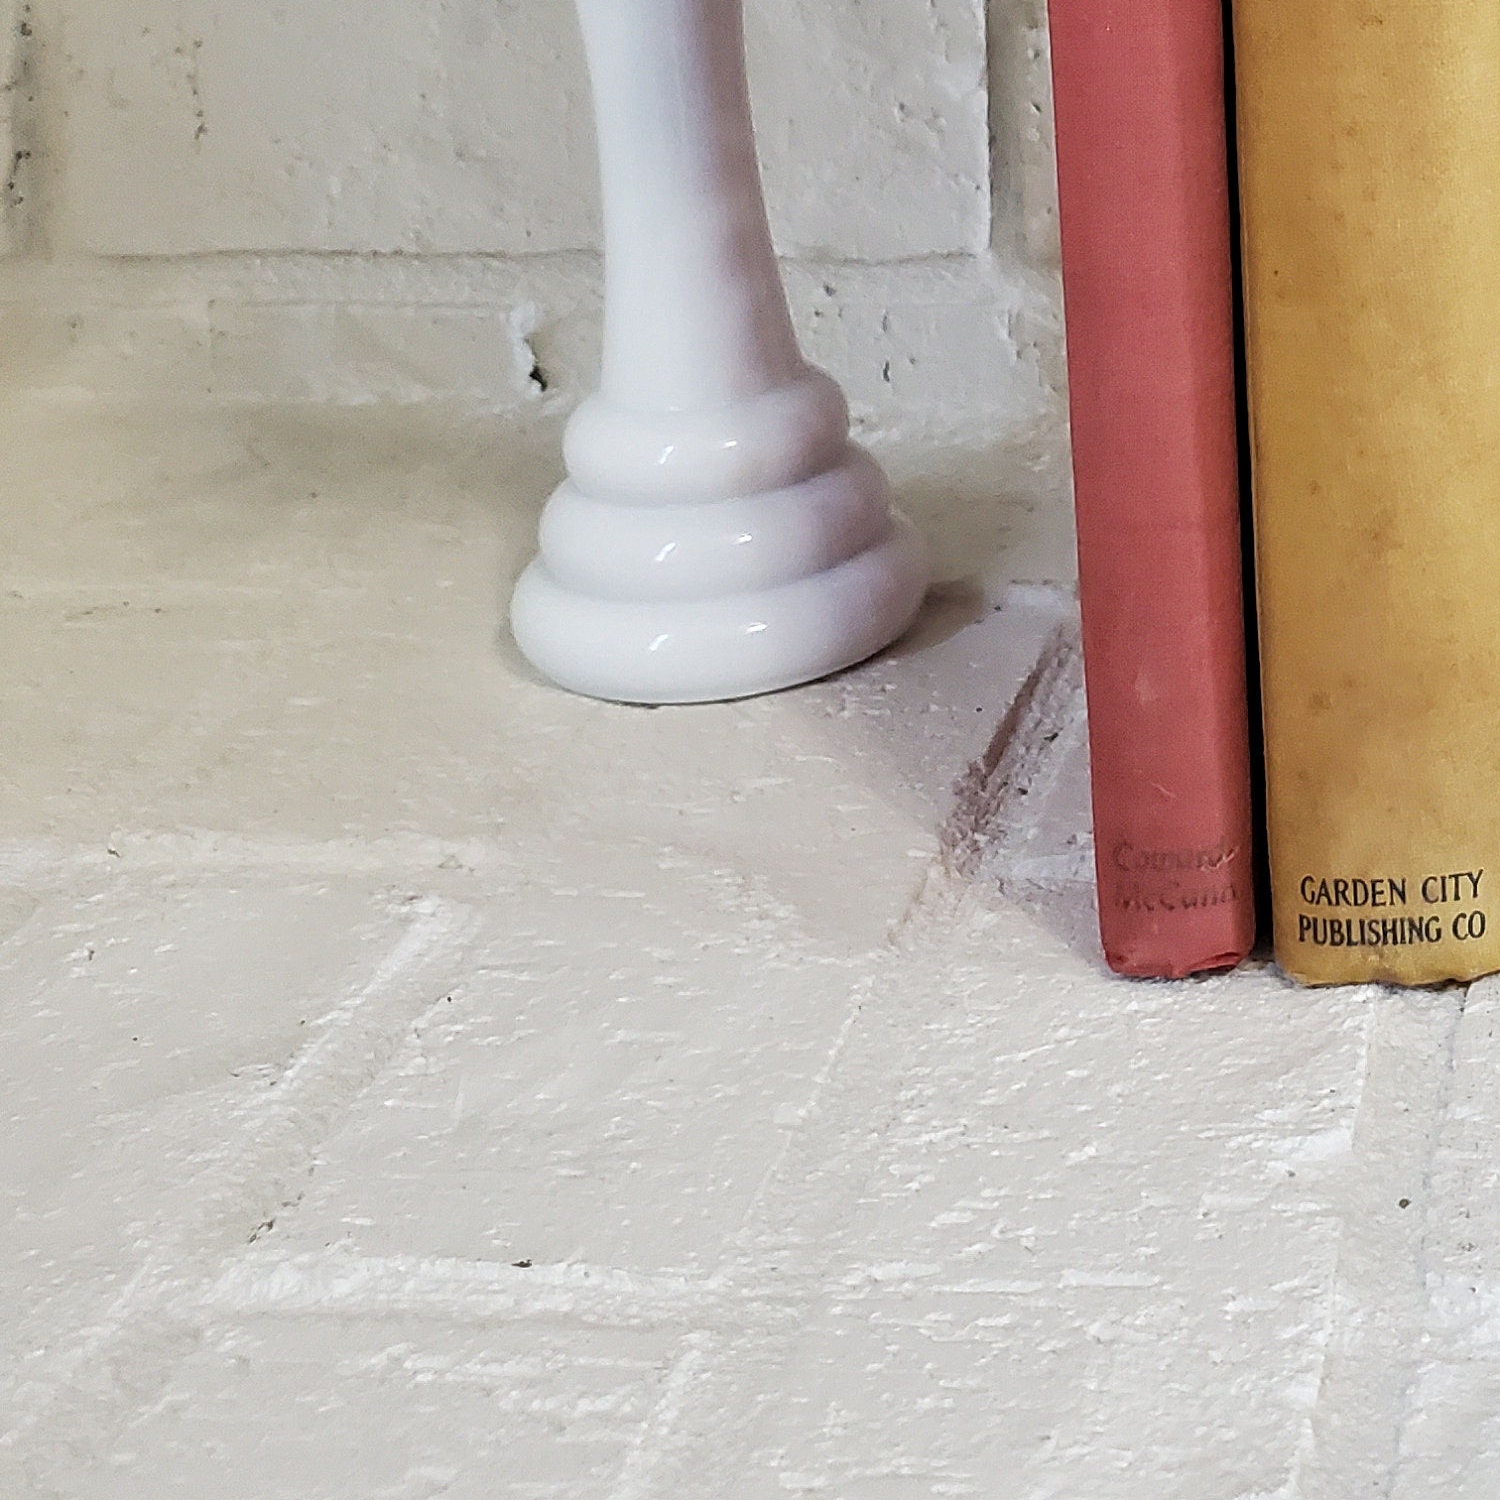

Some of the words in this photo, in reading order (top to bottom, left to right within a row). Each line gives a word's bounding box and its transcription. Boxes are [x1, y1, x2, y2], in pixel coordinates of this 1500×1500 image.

[1300, 875, 1406, 906] GARDEN
[1421, 868, 1484, 903] CITY
[1298, 913, 1442, 946] PUBLISHING
[1452, 910, 1486, 941] CO
